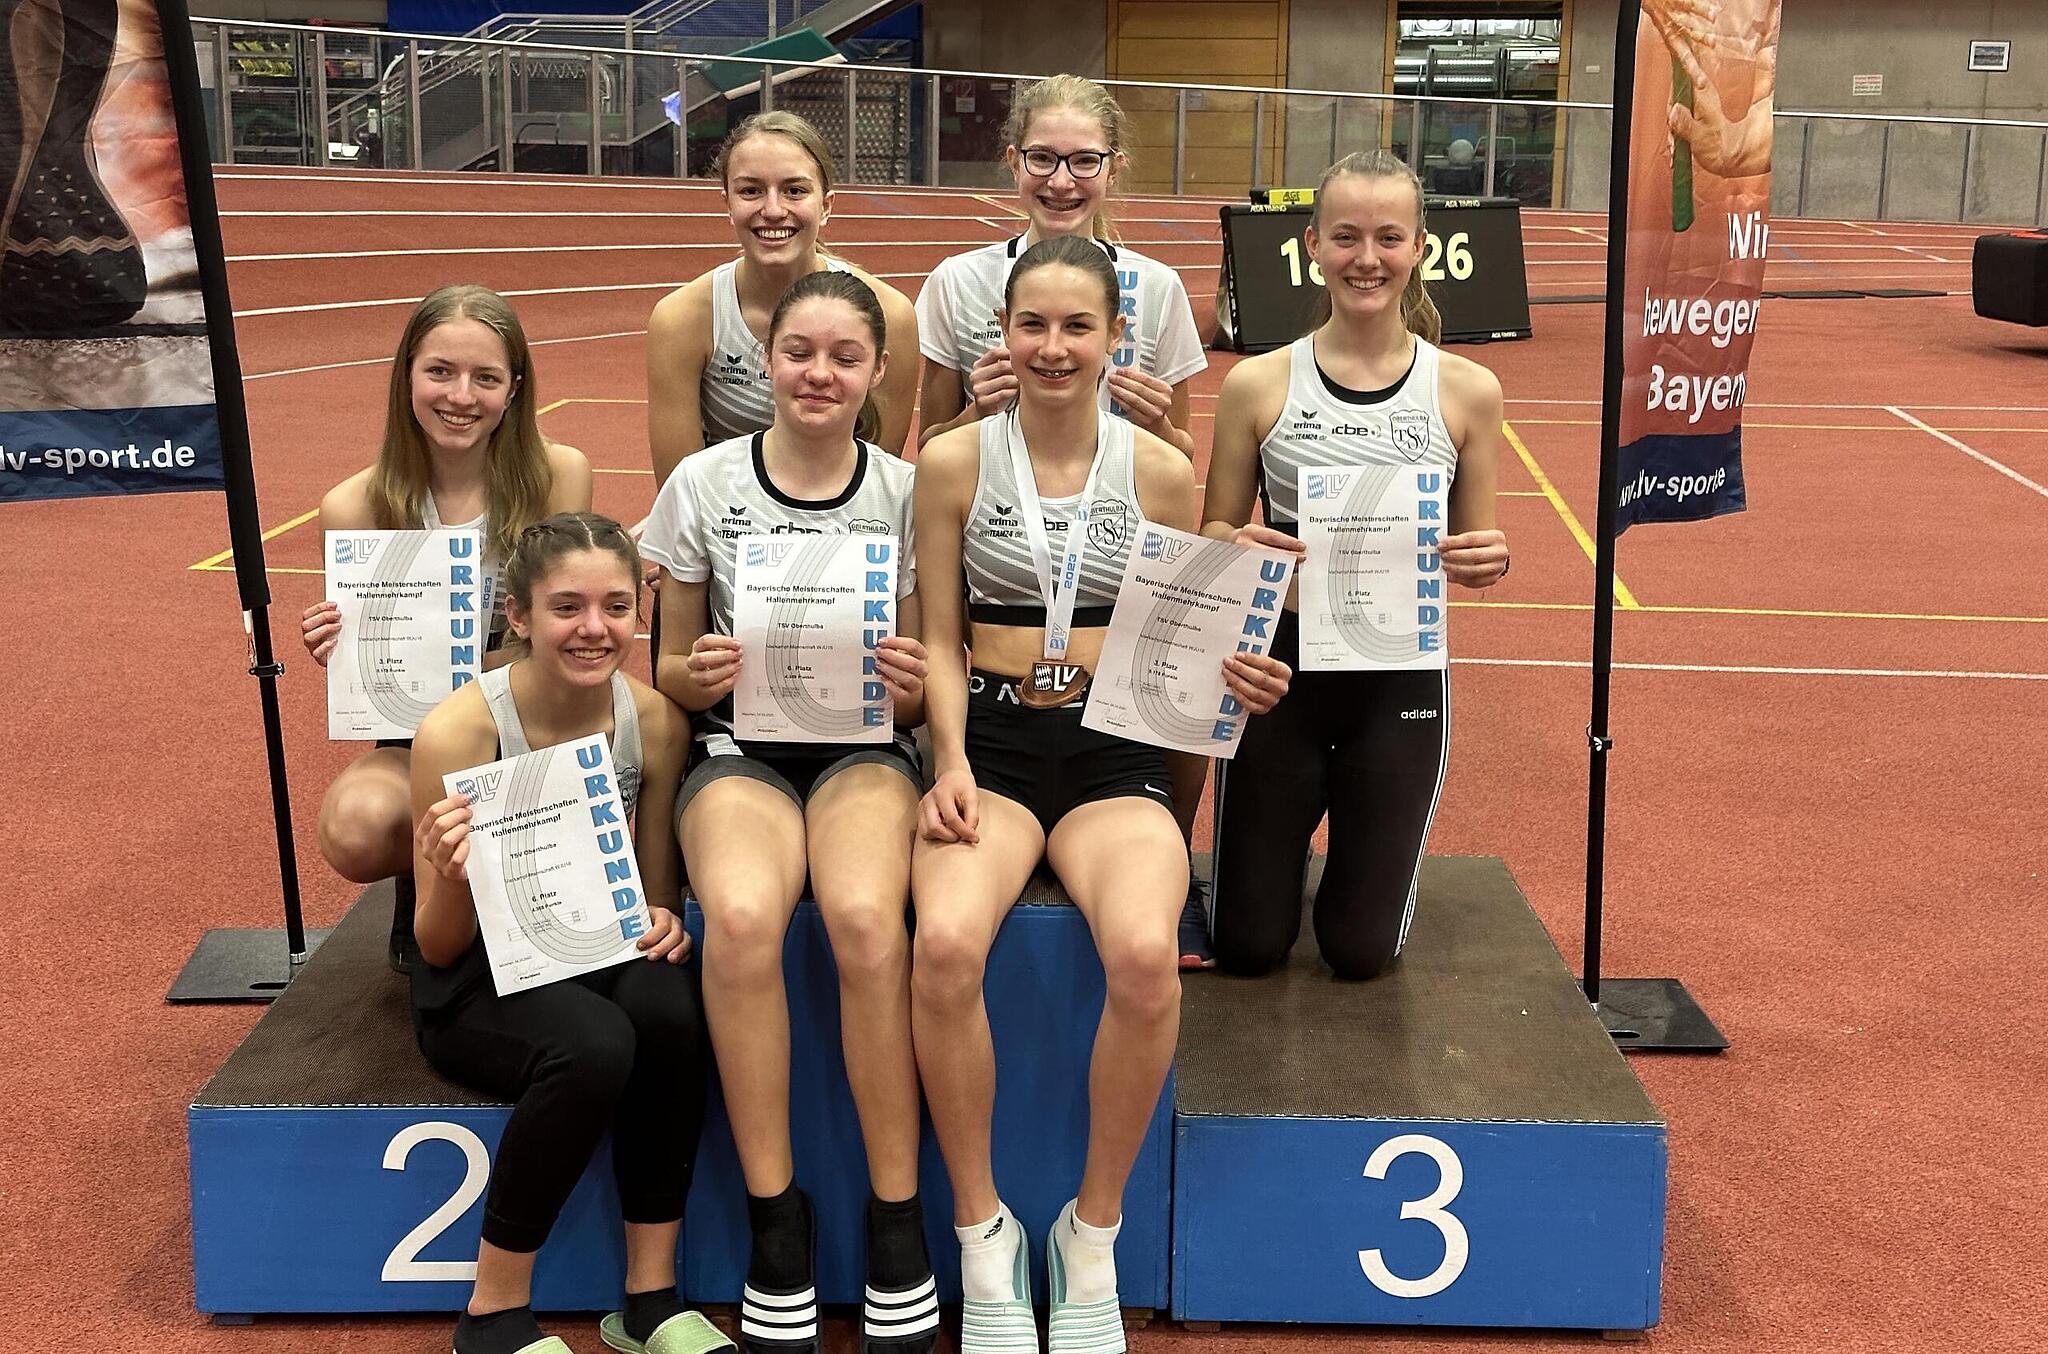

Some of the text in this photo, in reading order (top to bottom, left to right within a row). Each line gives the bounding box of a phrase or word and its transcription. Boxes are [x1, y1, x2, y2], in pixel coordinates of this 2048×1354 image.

[720, 366, 748, 375] erima
[1293, 421, 1322, 430] erima
[1394, 425, 1426, 450] TSV
[1308, 474, 1350, 499] BLV
[721, 517, 752, 527] erima
[988, 517, 1018, 527] erima
[1089, 519, 1124, 545] TSV
[1309, 515, 1409, 524] Bayerische Meisterschaften
[1327, 525, 1391, 534] Hallenmehrkampf
[335, 538, 380, 564] BLV
[746, 543, 794, 568] BLV
[1141, 531, 1193, 564] BLV
[1063, 553, 1078, 589] 2023
[1417, 473, 1441, 652] URKUNDE
[337, 580, 442, 590] Bayerische Meisterschaften
[356, 591, 423, 600] Hallenmehrkampf
[746, 584, 856, 594] Bayerische Meisterschaften
[1135, 575, 1242, 607] Bayerische Meisterschaften
[766, 595, 835, 605] Hallenmehrkampf
[1151, 590, 1220, 613] Hallenmehrkampf
[1400, 708, 1438, 720] adidas
[470, 797, 579, 833] Bayerische Meisterschaften
[491, 812, 561, 839] Hallenmehrkampf
[576, 743, 645, 941] URKUNDE
[381, 1121, 491, 1281] 2
[1358, 1134, 1469, 1298] 3
